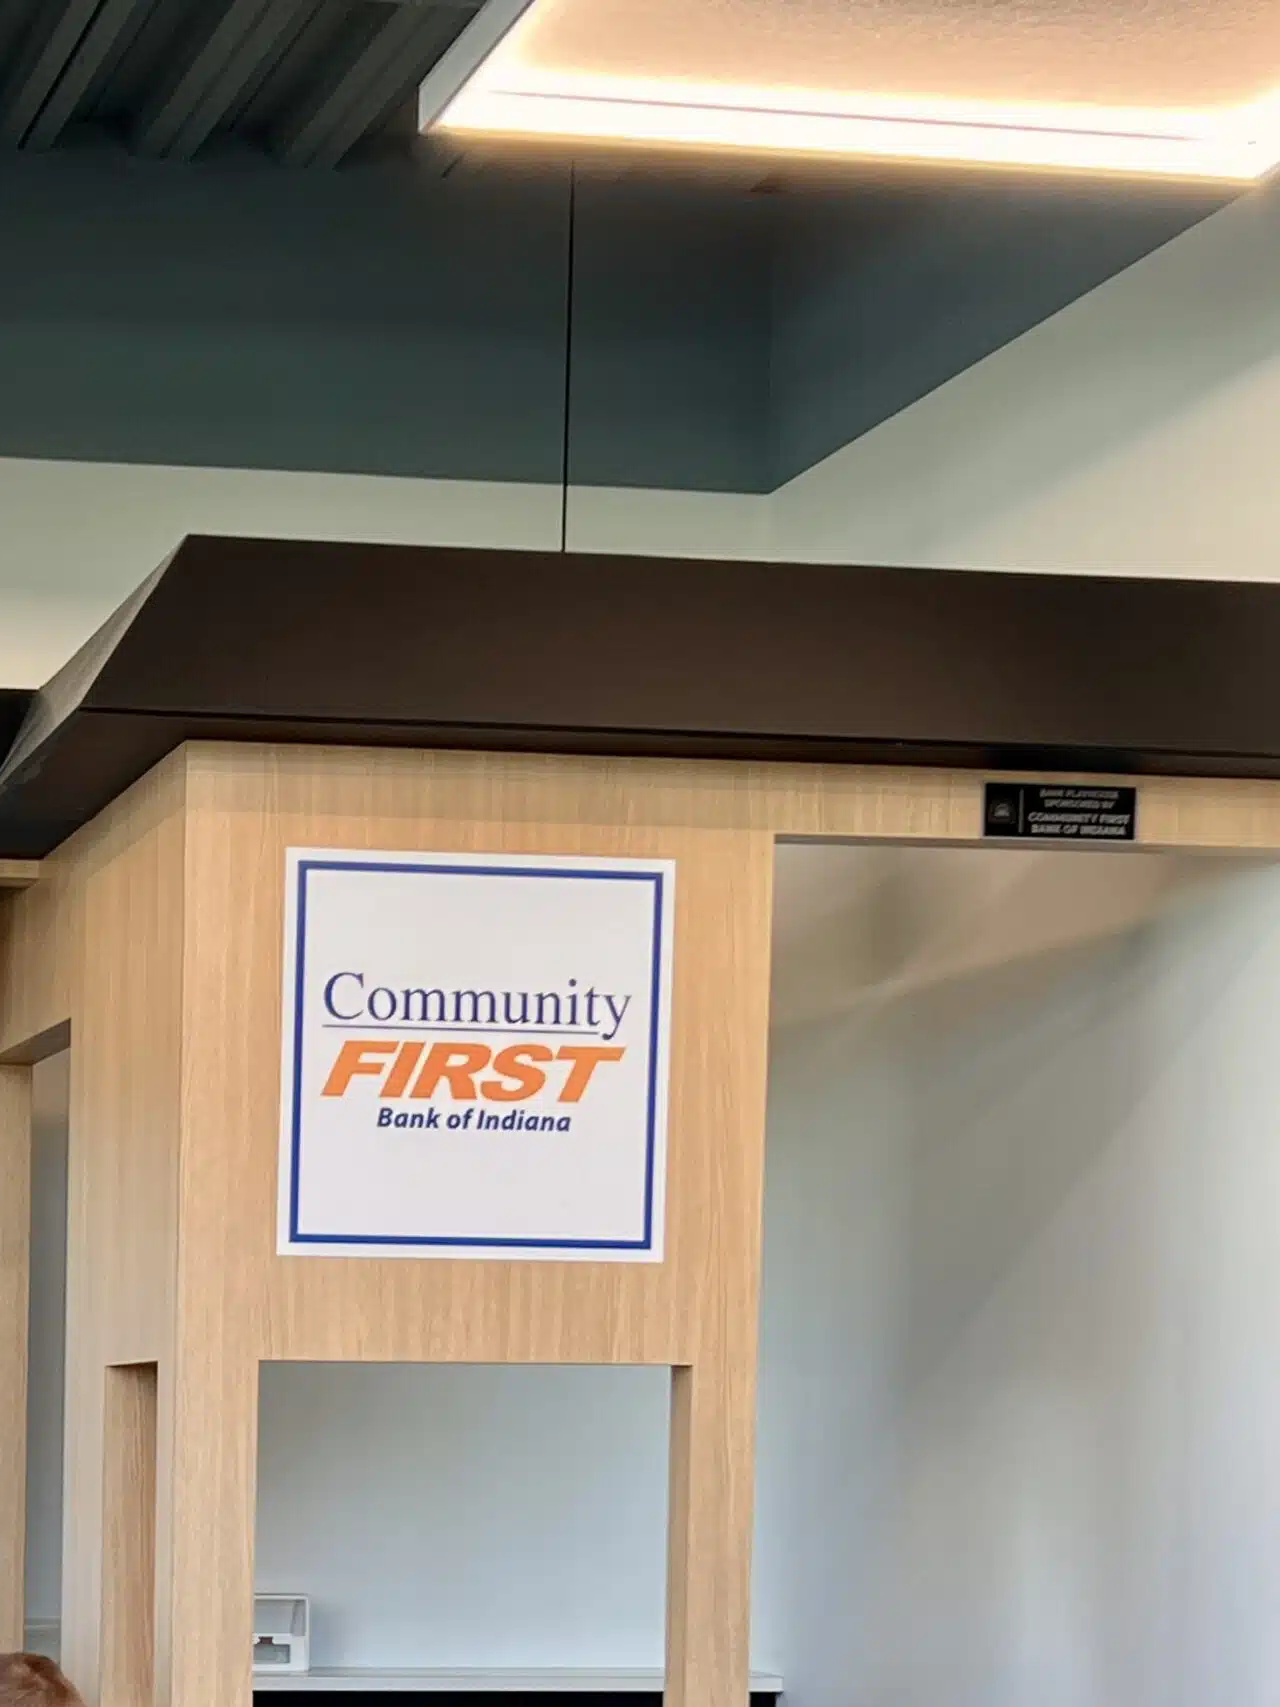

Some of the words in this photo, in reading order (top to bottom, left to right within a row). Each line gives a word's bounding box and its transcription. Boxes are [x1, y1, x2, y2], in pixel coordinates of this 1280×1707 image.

[1027, 811, 1099, 823] COMMUNITY
[1099, 813, 1130, 825] FIRST
[1031, 824, 1061, 834] BANK
[1063, 824, 1078, 834] OF
[1079, 825, 1126, 835] INDIANA
[322, 971, 632, 1041] Community
[320, 1039, 627, 1103] FIRST
[376, 1107, 441, 1131] Bank
[445, 1108, 474, 1131] of
[475, 1109, 572, 1133] Indiana
